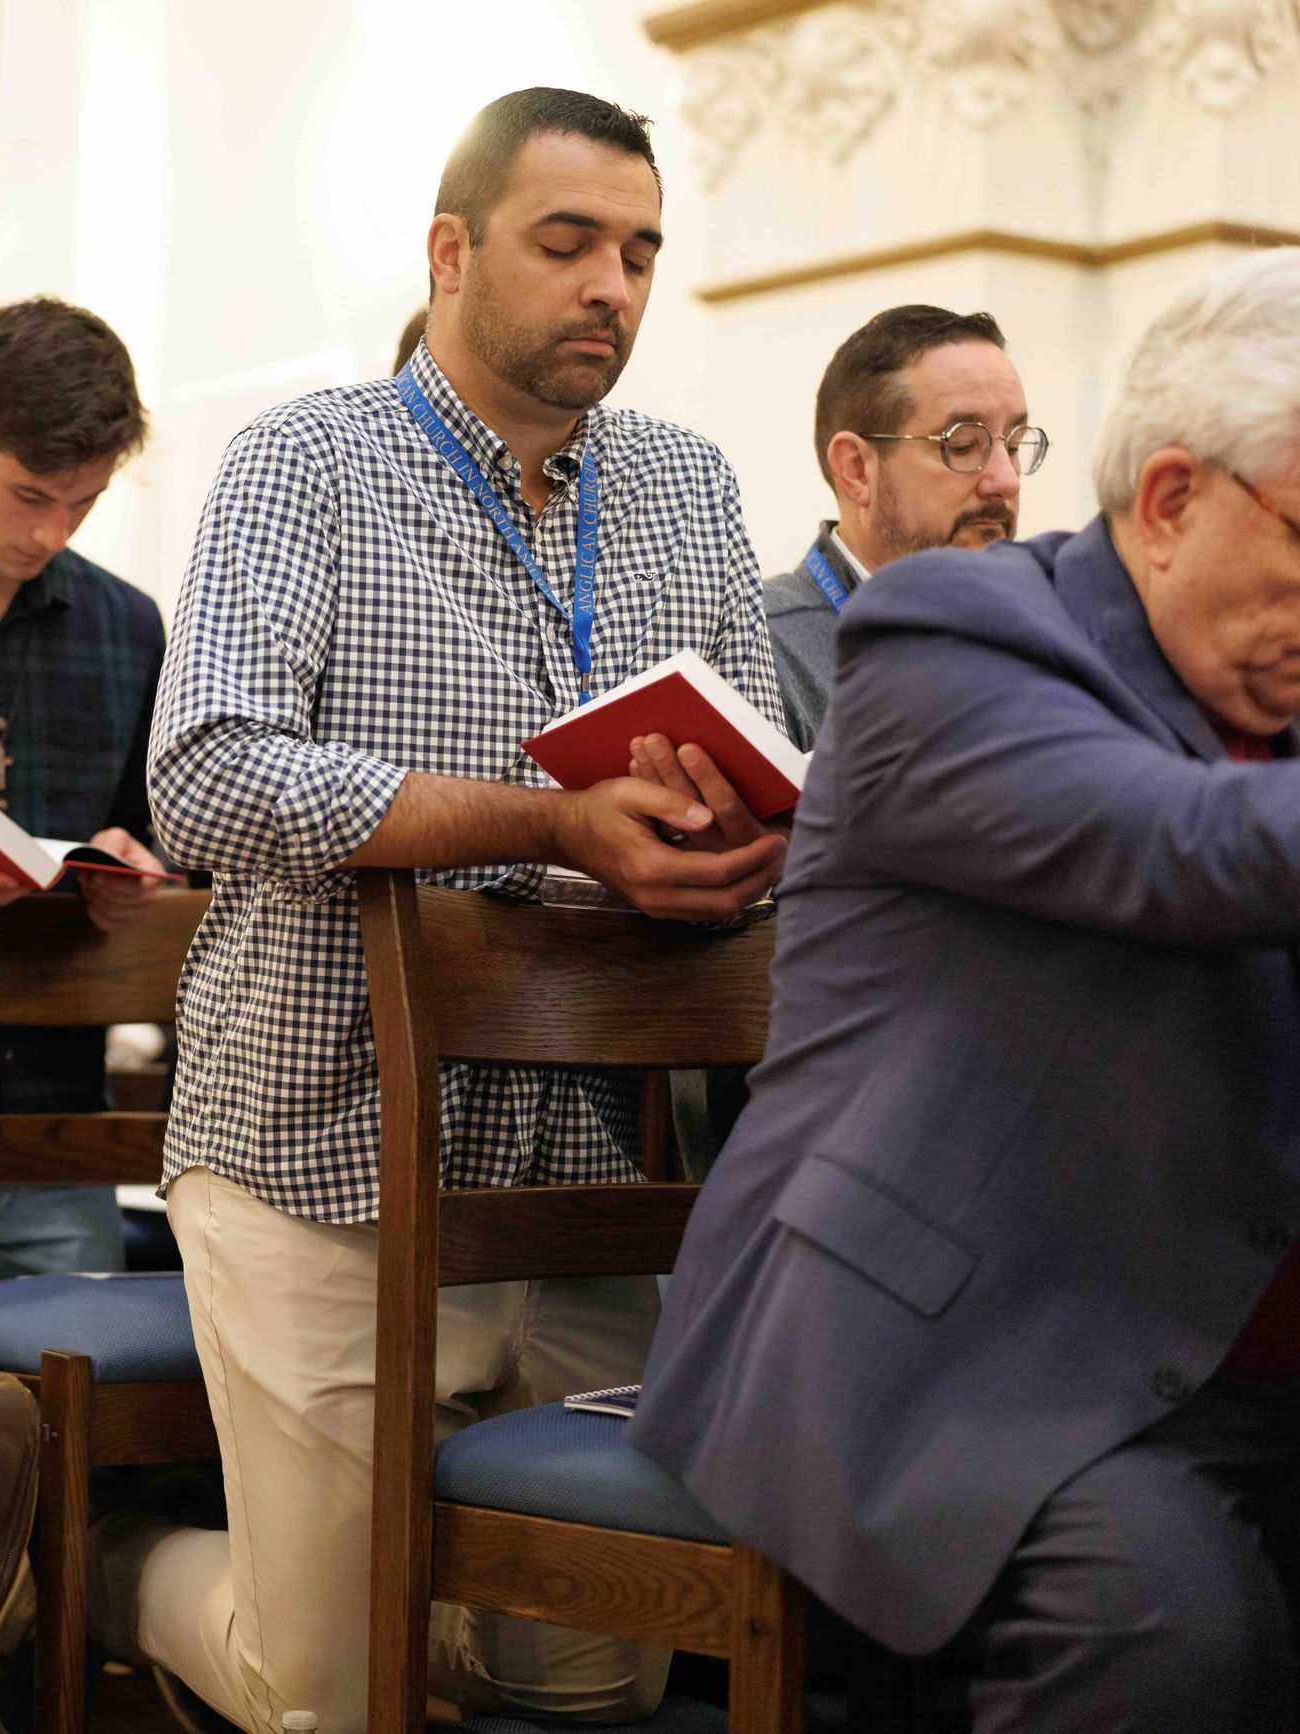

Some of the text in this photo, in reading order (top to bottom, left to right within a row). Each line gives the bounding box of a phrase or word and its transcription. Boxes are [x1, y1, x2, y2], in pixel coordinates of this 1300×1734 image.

[411, 403, 463, 465] CHURCH
[458, 461, 478, 482] IN
[473, 482, 516, 541] NORTH
[511, 542, 553, 598] AMERI
[582, 462, 597, 525] CHURCH
[578, 528, 597, 616] ANGLICAN
